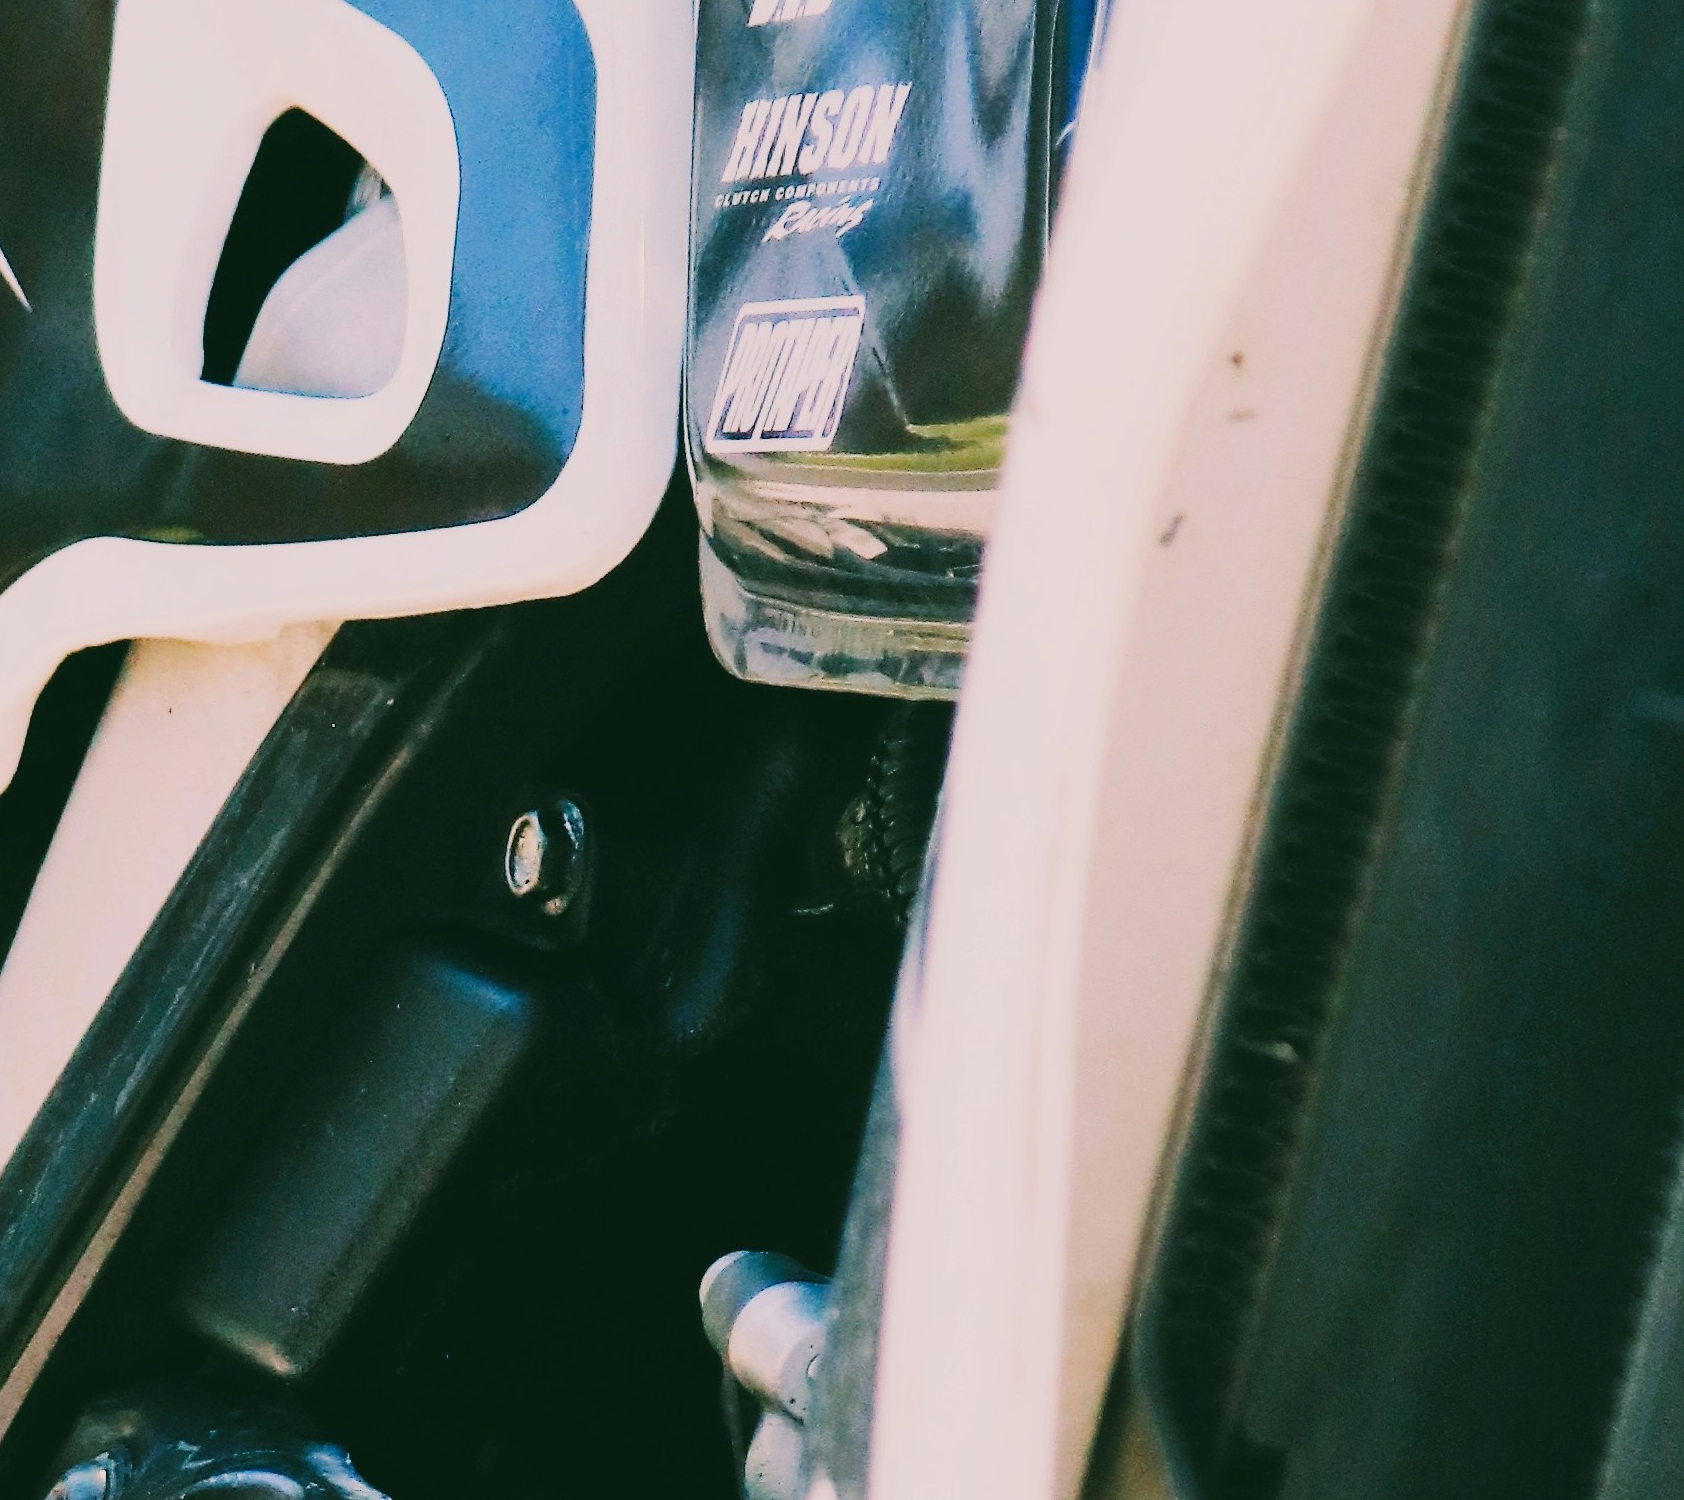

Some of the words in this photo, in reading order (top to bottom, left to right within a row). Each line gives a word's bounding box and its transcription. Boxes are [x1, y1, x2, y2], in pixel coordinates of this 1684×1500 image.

[720, 81, 913, 183] HINSON
[715, 188, 771, 208] CLUTCH
[775, 177, 881, 201] COMPONENTS
[761, 196, 875, 243] Racing
